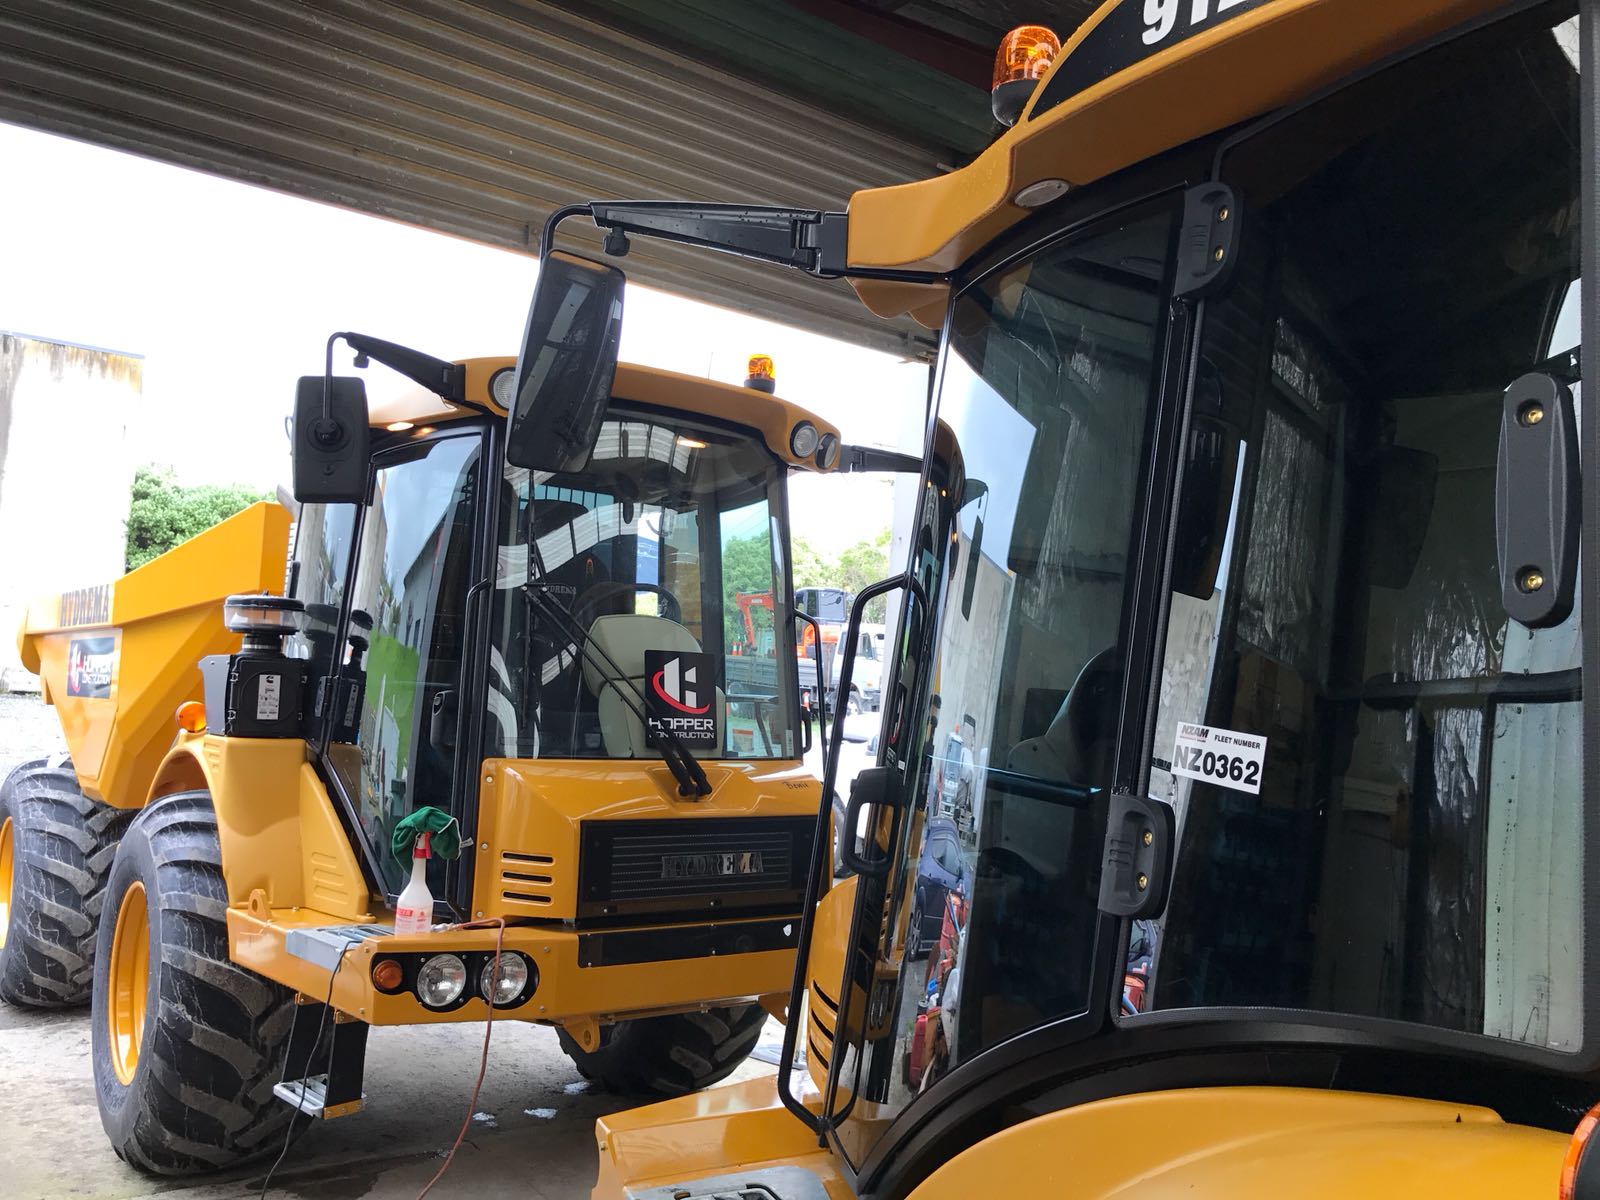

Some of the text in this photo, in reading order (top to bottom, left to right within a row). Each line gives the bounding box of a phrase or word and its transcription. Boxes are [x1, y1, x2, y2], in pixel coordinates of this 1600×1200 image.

[1181, 725, 1210, 738] NZAM
[1214, 734, 1233, 745] FLEET
[1233, 737, 1261, 750] NUMBER
[1173, 745, 1260, 786] NZ0362
